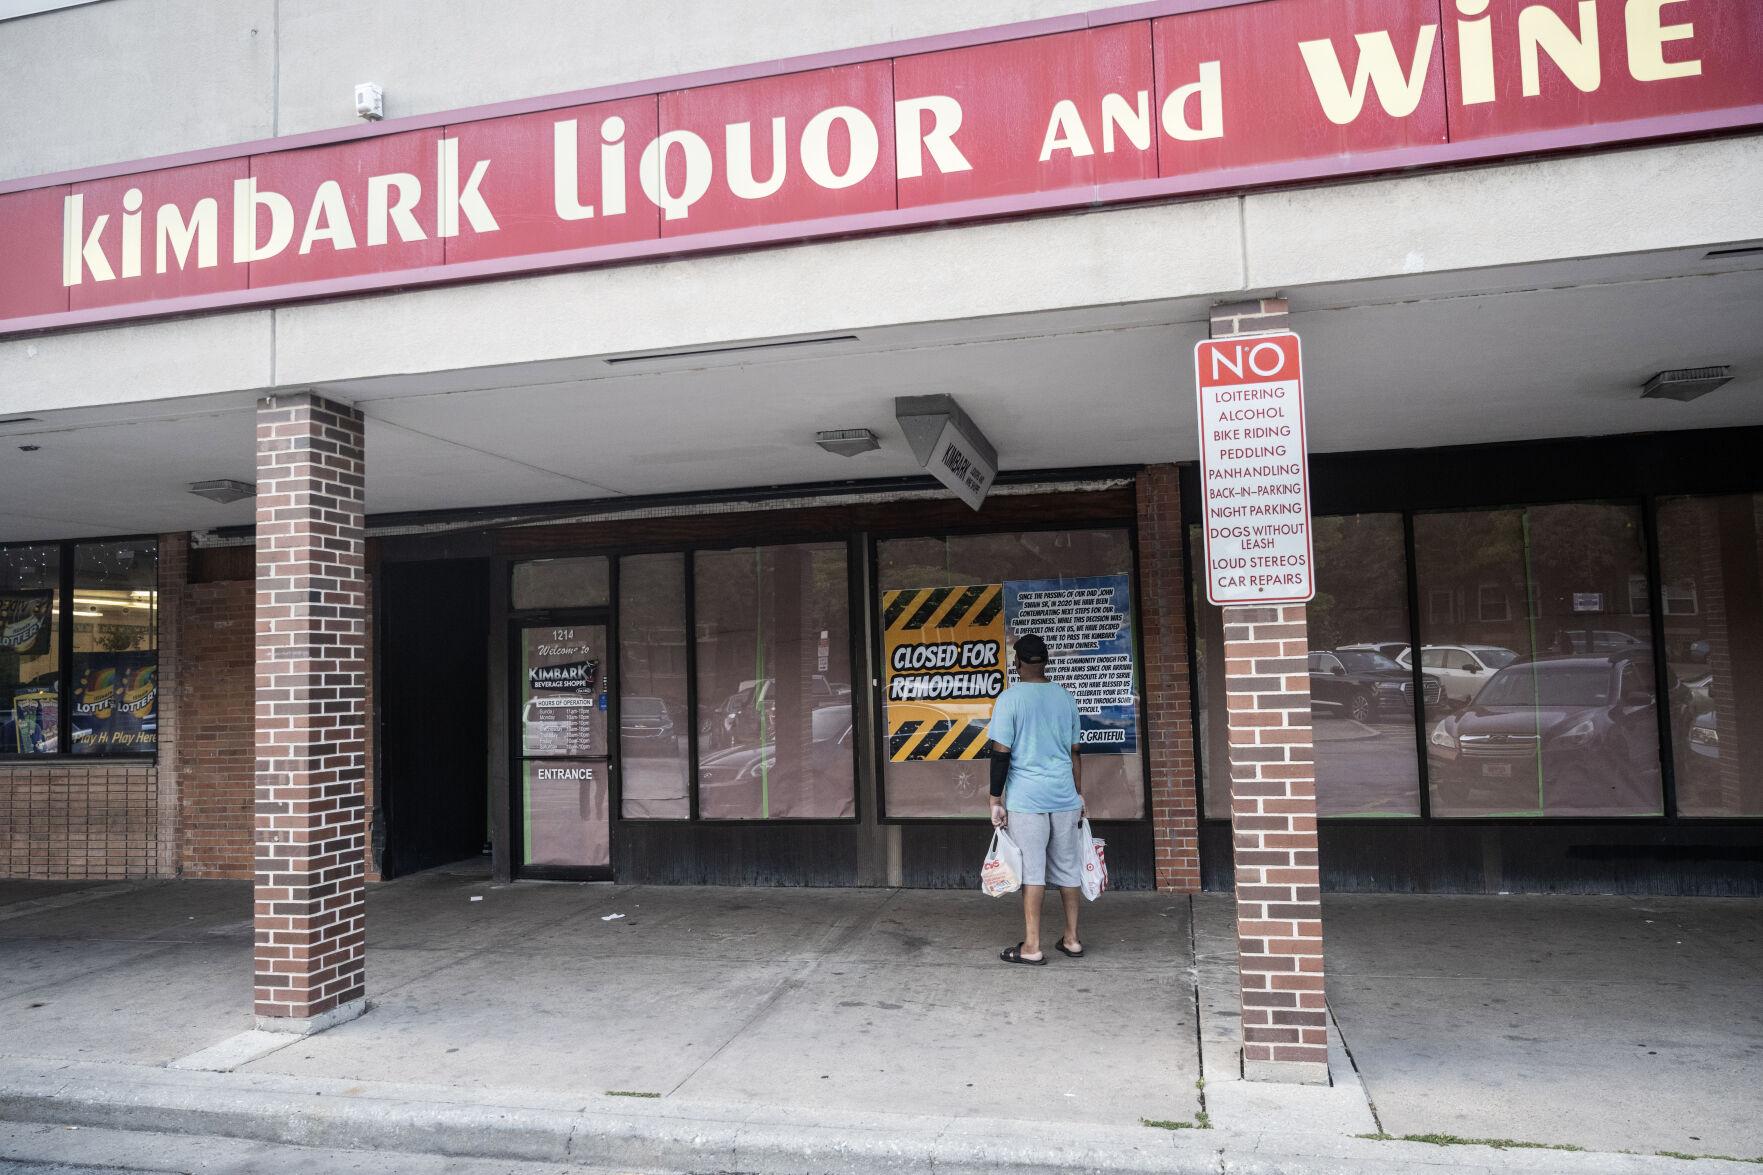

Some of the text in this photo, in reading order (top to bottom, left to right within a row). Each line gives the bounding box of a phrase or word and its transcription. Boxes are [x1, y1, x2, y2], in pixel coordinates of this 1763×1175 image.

[1212, 342, 1285, 379] NO
[1215, 387, 1285, 403] LOITERING
[1219, 407, 1285, 422] ALCOHOL
[1214, 425, 1291, 442] BIKE RIDING
[1220, 445, 1287, 460] PEDDLING
[1209, 464, 1300, 480] PANHANDLING
[1209, 483, 1301, 499] BACK-IN-PARKING
[1211, 502, 1302, 518] NIGHT PARKING
[1211, 523, 1304, 539] DOGS WITHOUT
[1241, 538, 1275, 550] LEASH
[1212, 554, 1306, 570] LOUD STEREOS
[1218, 572, 1303, 588] CAR REPAIRS
[1018, 592, 1032, 600] SINCE
[1012, 618, 1030, 626] FAMILY
[1058, 616, 1072, 624] WHILE
[553, 630, 574, 640] 1214
[1020, 626, 1044, 634] DIFFICULT
[1056, 624, 1066, 632] FOR
[1046, 634, 1058, 642] TIME
[581, 645, 590, 654] to
[1056, 642, 1062, 650] TO
[894, 642, 998, 670] CLOSED FOR
[528, 665, 590, 681] KIMBARK
[534, 680, 586, 688] BEVERAGE SHOPPE
[892, 672, 1002, 698] REMODELING
[112, 731, 135, 746] Play
[1087, 731, 1124, 742] GRATEFUL
[538, 768, 592, 780] ENTRANCE
